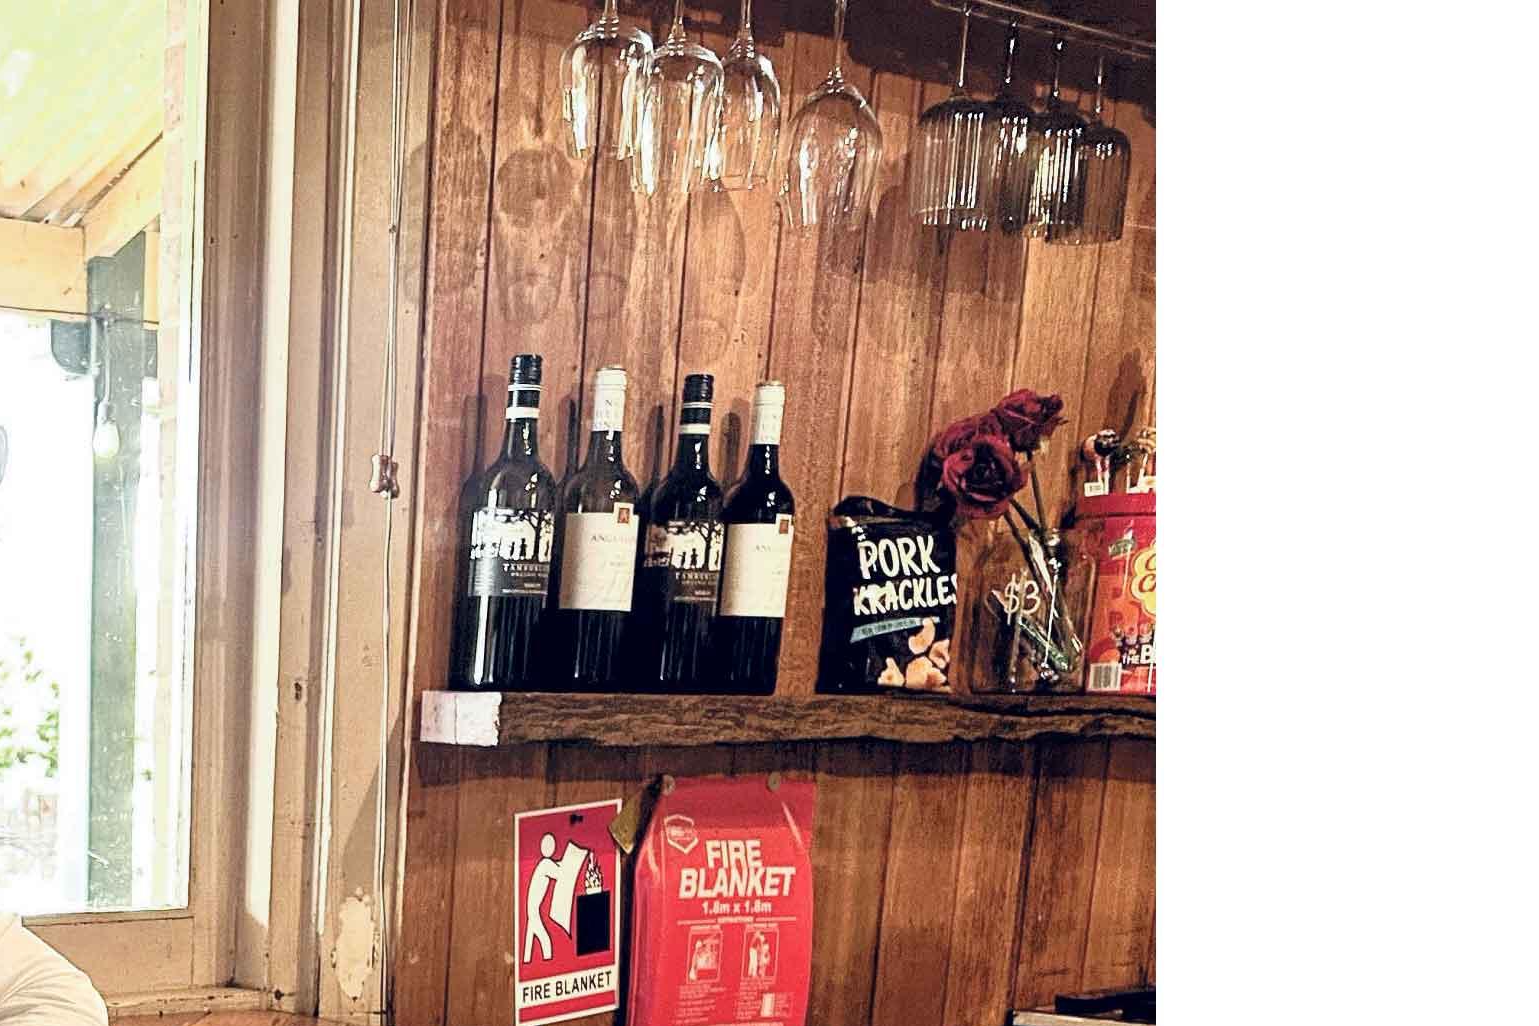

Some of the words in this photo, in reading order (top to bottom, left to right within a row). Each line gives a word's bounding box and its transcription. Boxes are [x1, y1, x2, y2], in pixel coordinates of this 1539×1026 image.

[858, 535, 941, 580] PORK
[1004, 570, 1042, 625] $3
[706, 839, 763, 869] FIRE
[678, 866, 797, 900] BLANKET
[522, 982, 551, 1003] FIRE
[555, 970, 612, 997] BLANKET
